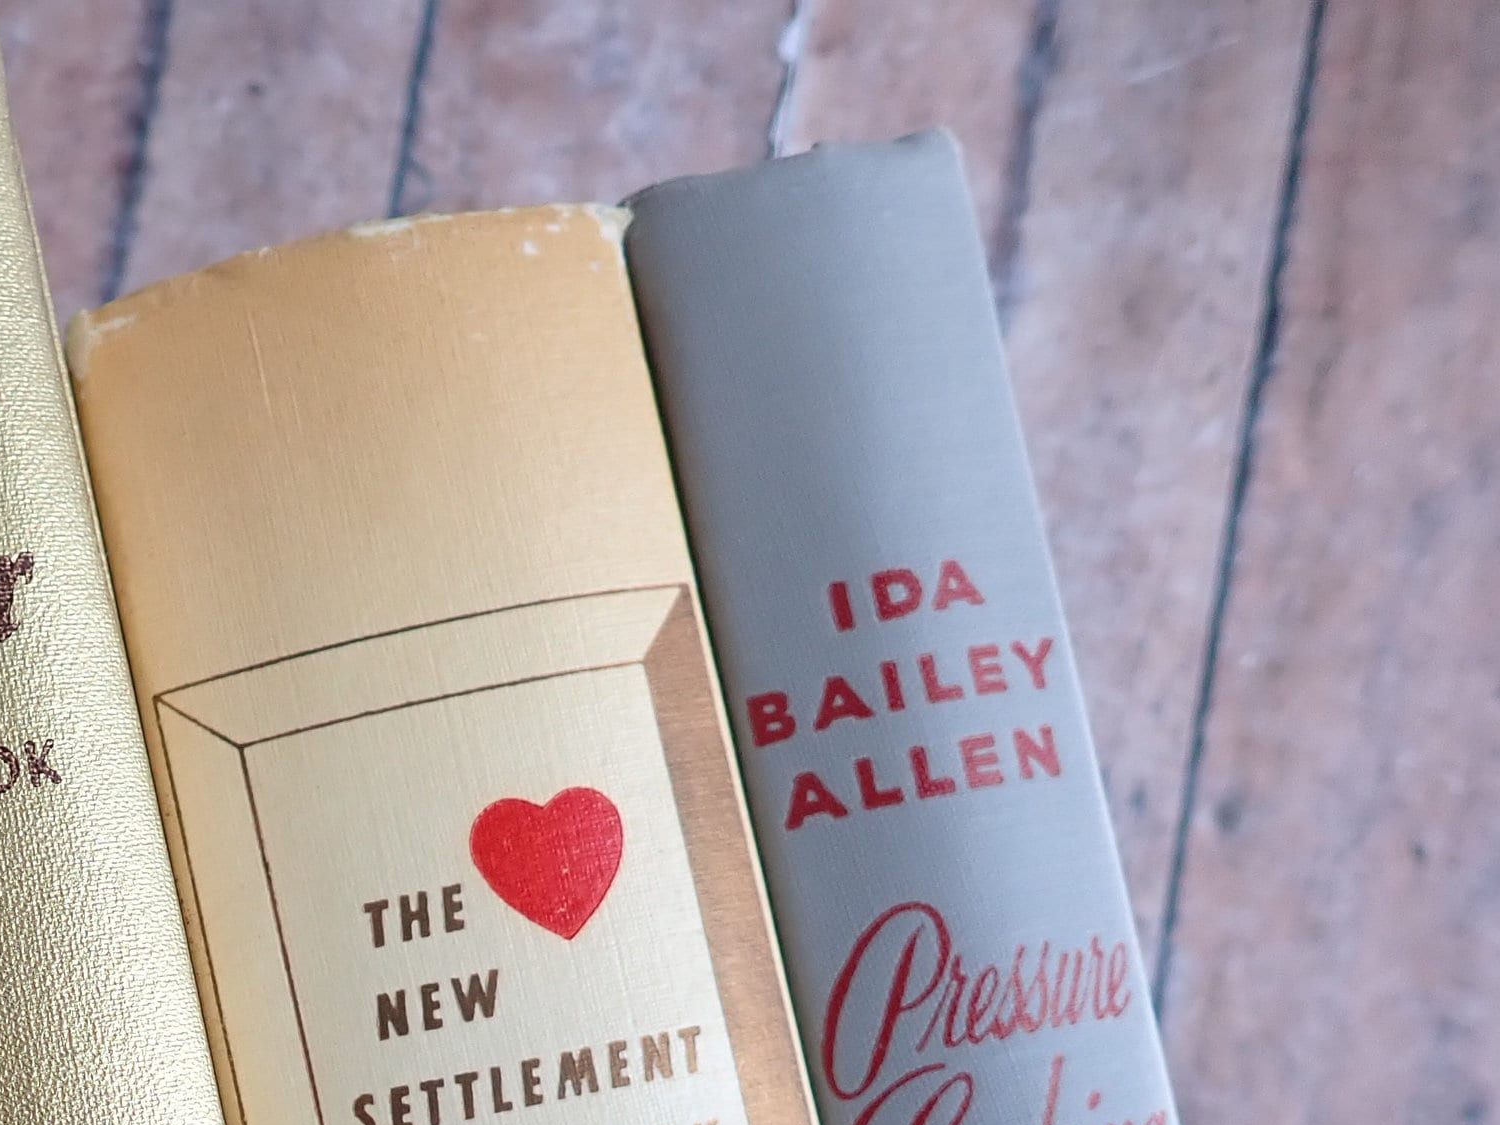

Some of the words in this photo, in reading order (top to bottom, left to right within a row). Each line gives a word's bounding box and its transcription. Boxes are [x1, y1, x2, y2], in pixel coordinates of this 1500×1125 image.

[827, 559, 986, 633] IDA
[746, 637, 1056, 748] BAILEY
[785, 724, 1062, 831] ALLEN
[363, 883, 466, 949] THE
[376, 968, 499, 1042] NEW
[819, 900, 1133, 1101] Pressure
